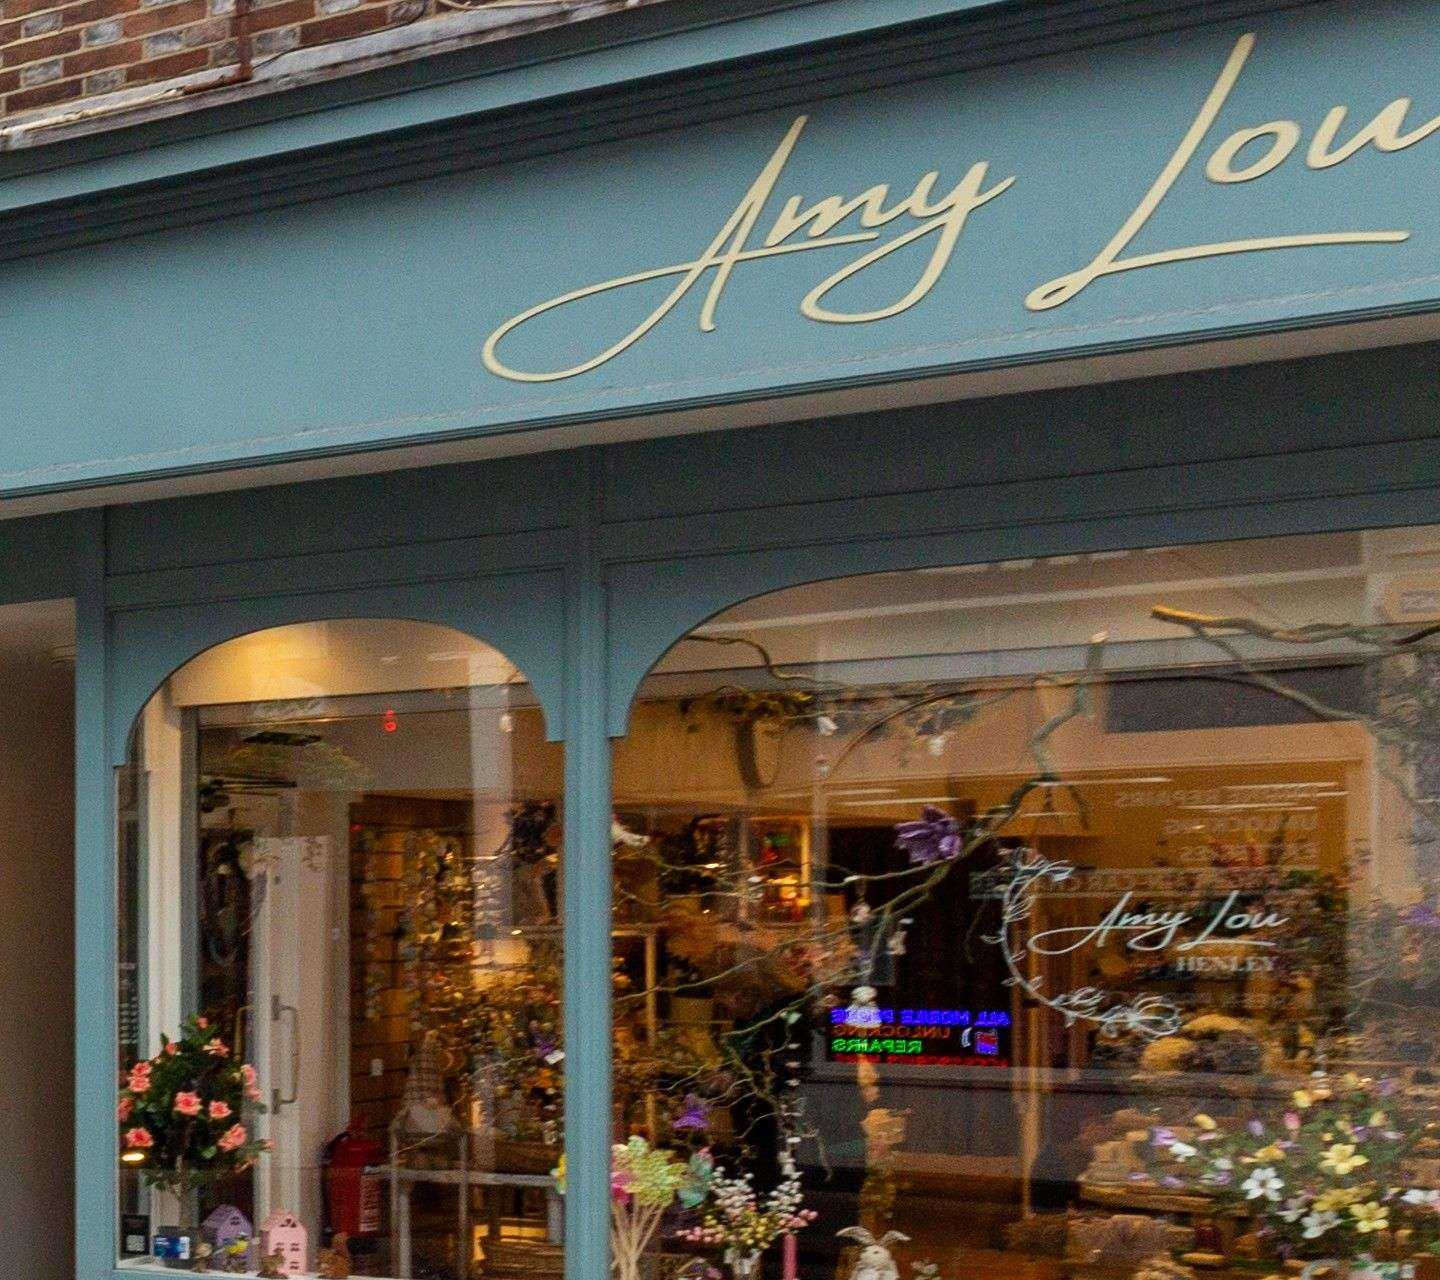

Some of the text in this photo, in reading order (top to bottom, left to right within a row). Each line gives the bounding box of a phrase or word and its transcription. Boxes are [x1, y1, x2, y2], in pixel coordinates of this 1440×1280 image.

[482, 32, 1440, 383] Amy Lou
[1027, 889, 1291, 956] Amy Lou
[1175, 956, 1275, 972] HENLEY
